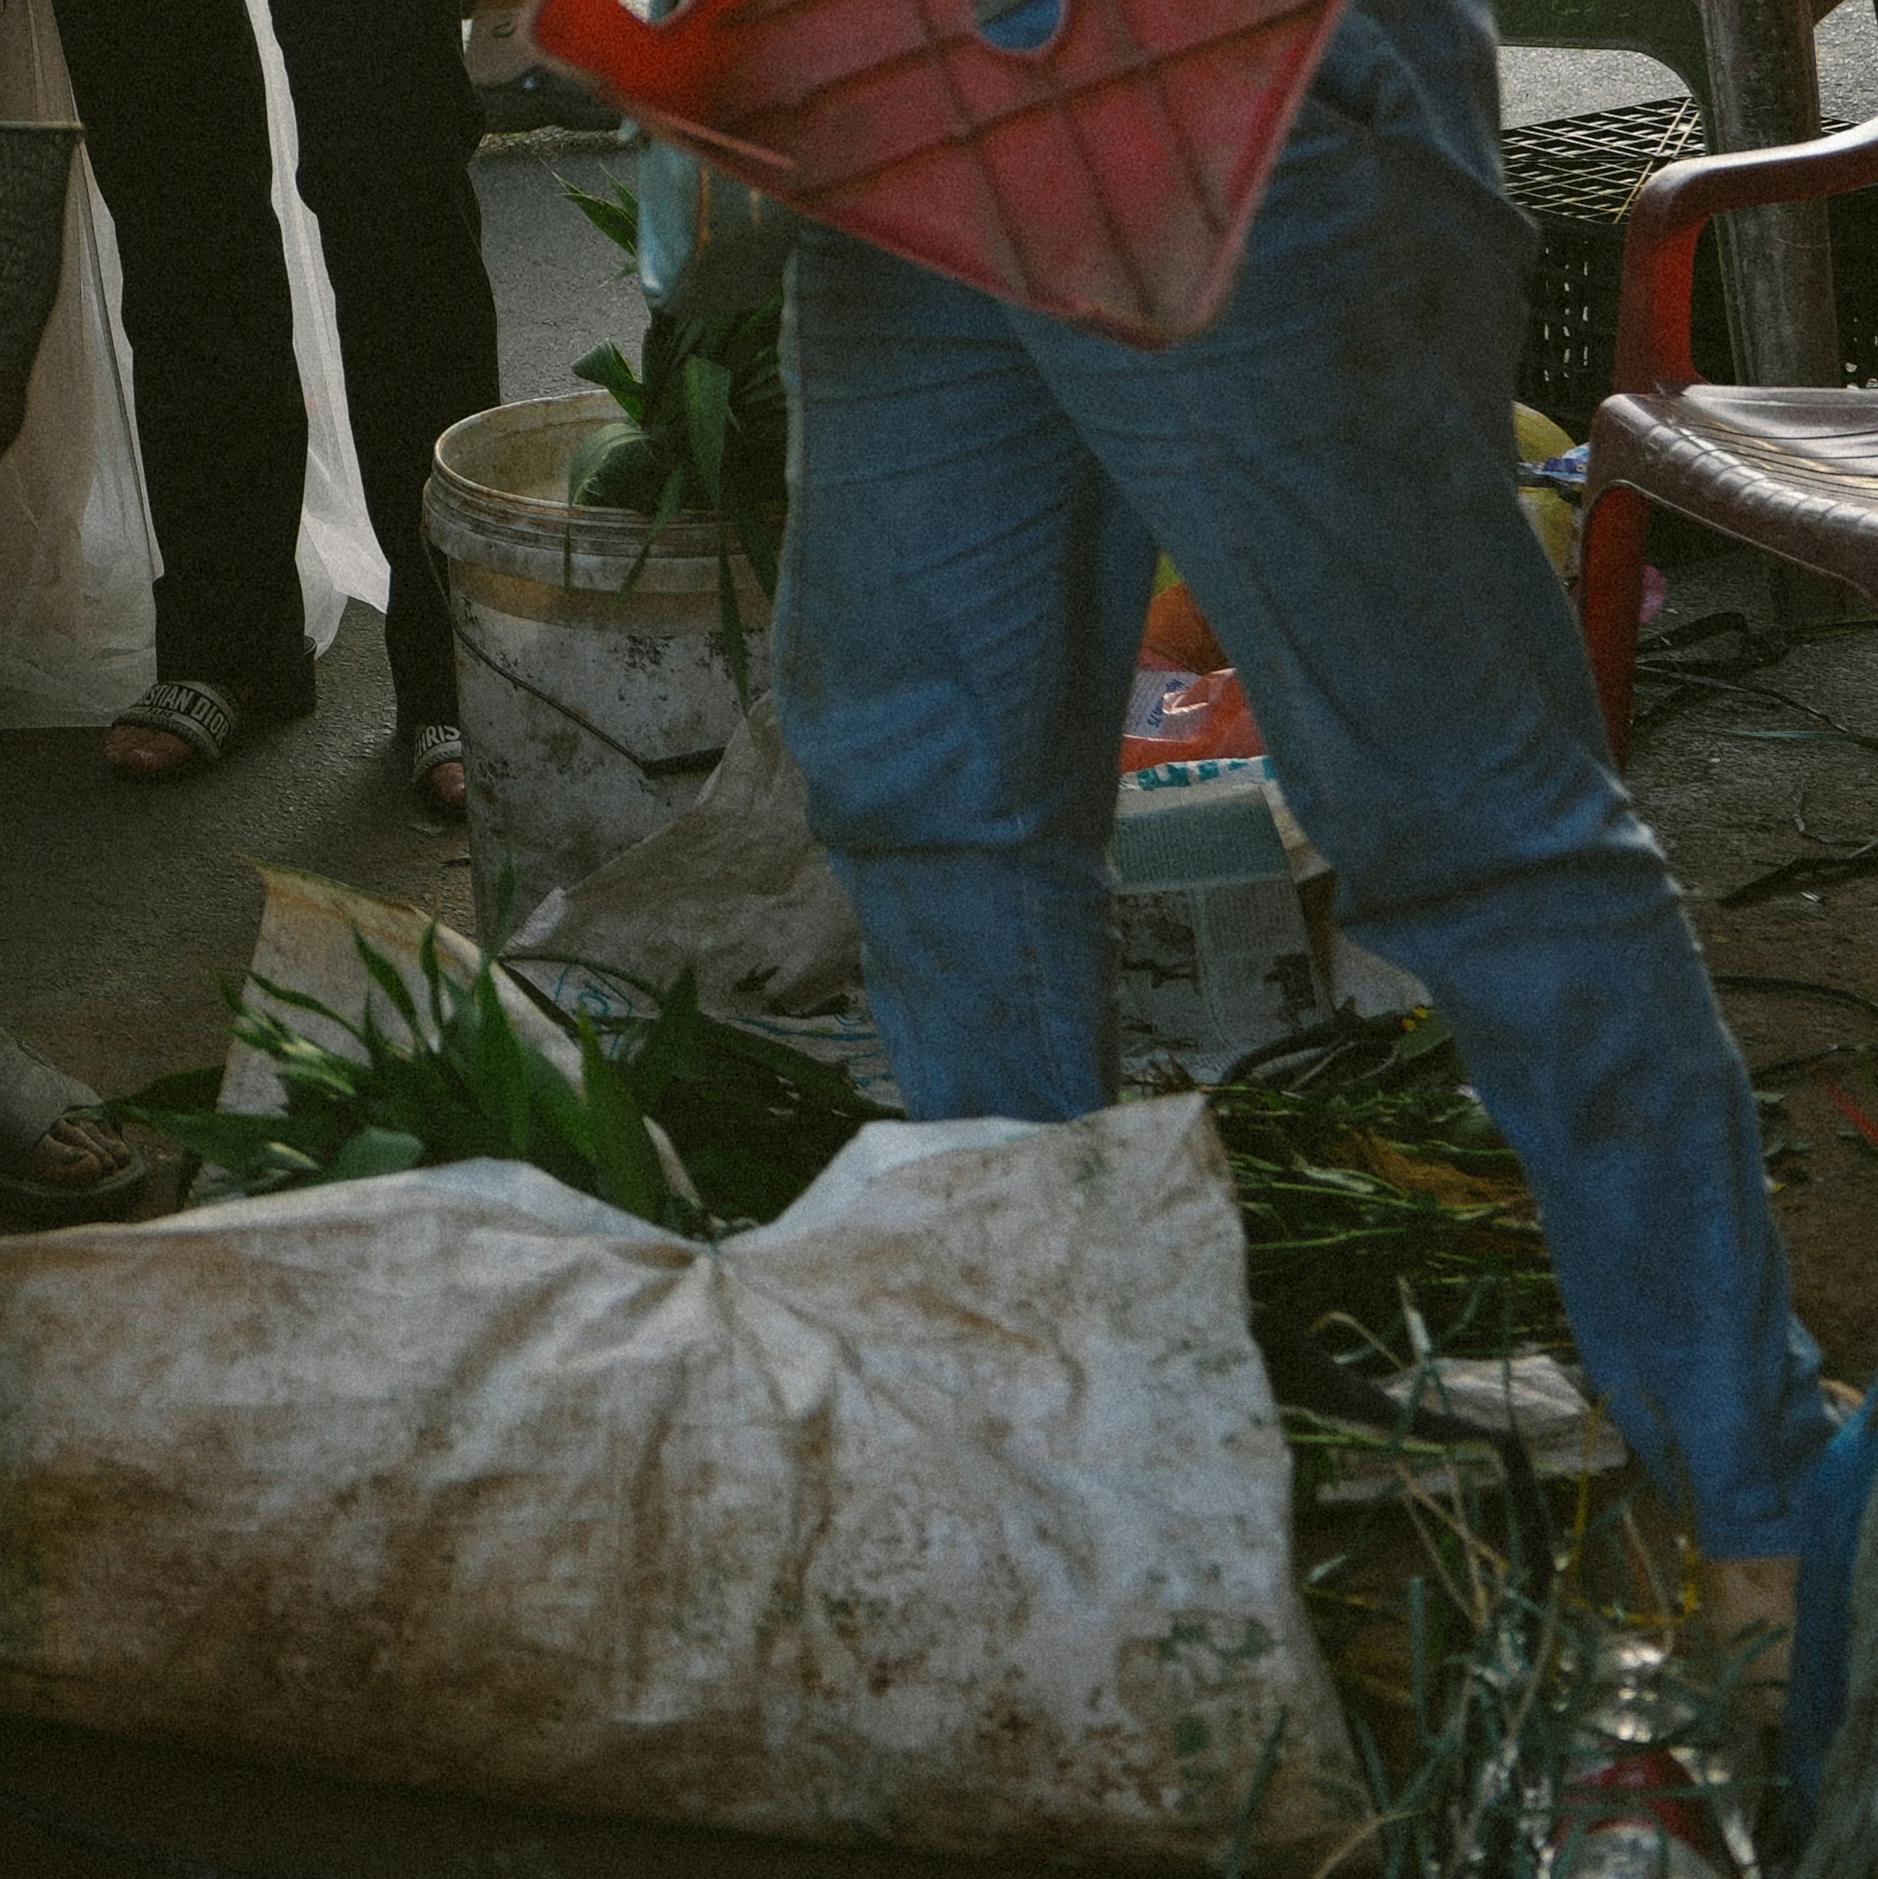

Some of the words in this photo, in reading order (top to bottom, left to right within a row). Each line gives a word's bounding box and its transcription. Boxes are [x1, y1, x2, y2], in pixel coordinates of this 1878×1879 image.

[141, 684, 195, 714] STIAN
[190, 697, 229, 747] DIOR
[414, 724, 461, 764] CHRIS
